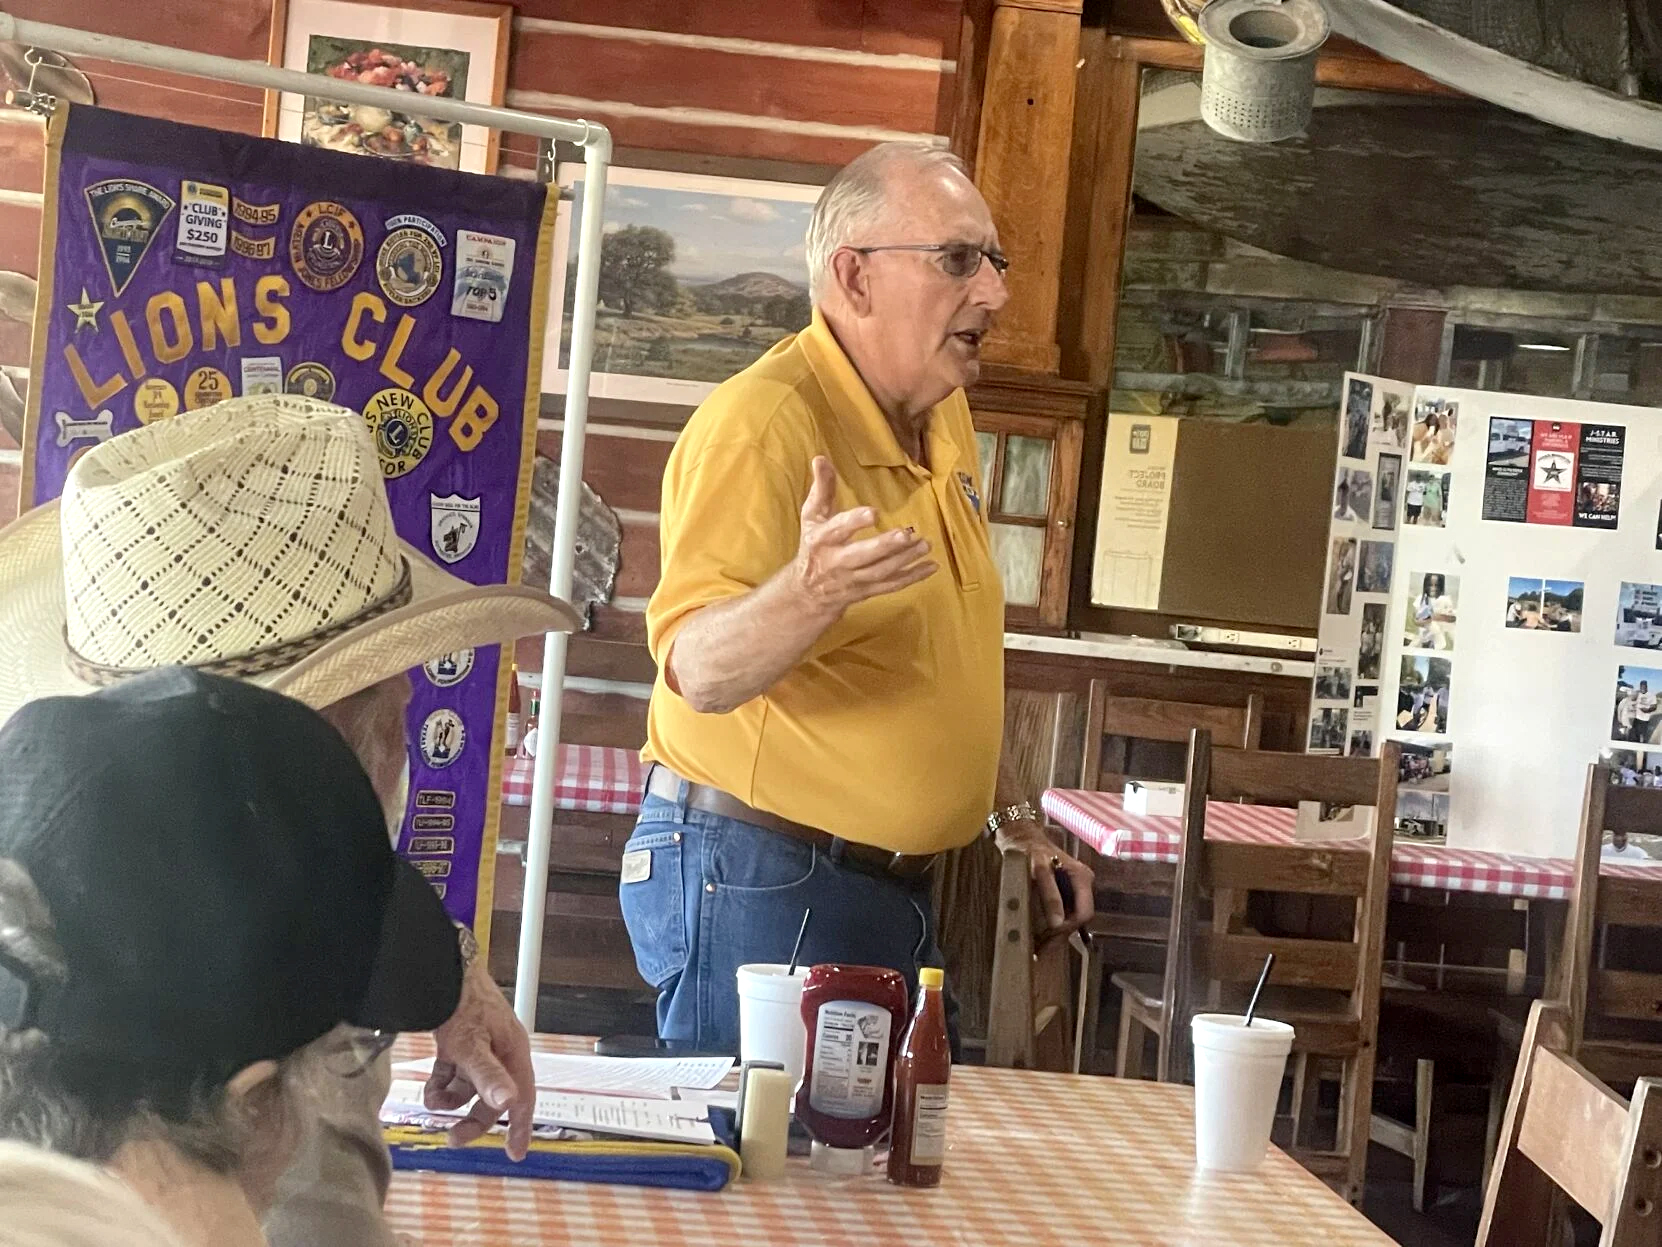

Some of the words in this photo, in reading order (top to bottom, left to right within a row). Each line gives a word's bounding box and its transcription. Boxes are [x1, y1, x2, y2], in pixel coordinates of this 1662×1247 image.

[192, 203, 218, 217] CLUB
[185, 214, 223, 229] GIVING
[187, 229, 219, 243] $250
[403, 215, 446, 246] PARTICIPATION
[488, 287, 498, 302] 5
[64, 274, 291, 410] LIONS
[341, 291, 499, 452] CLUB
[198, 370, 219, 391] 25
[376, 391, 415, 411] NEW
[412, 412, 431, 460] CLUB
[1585, 436, 1620, 445] MINISTRIES
